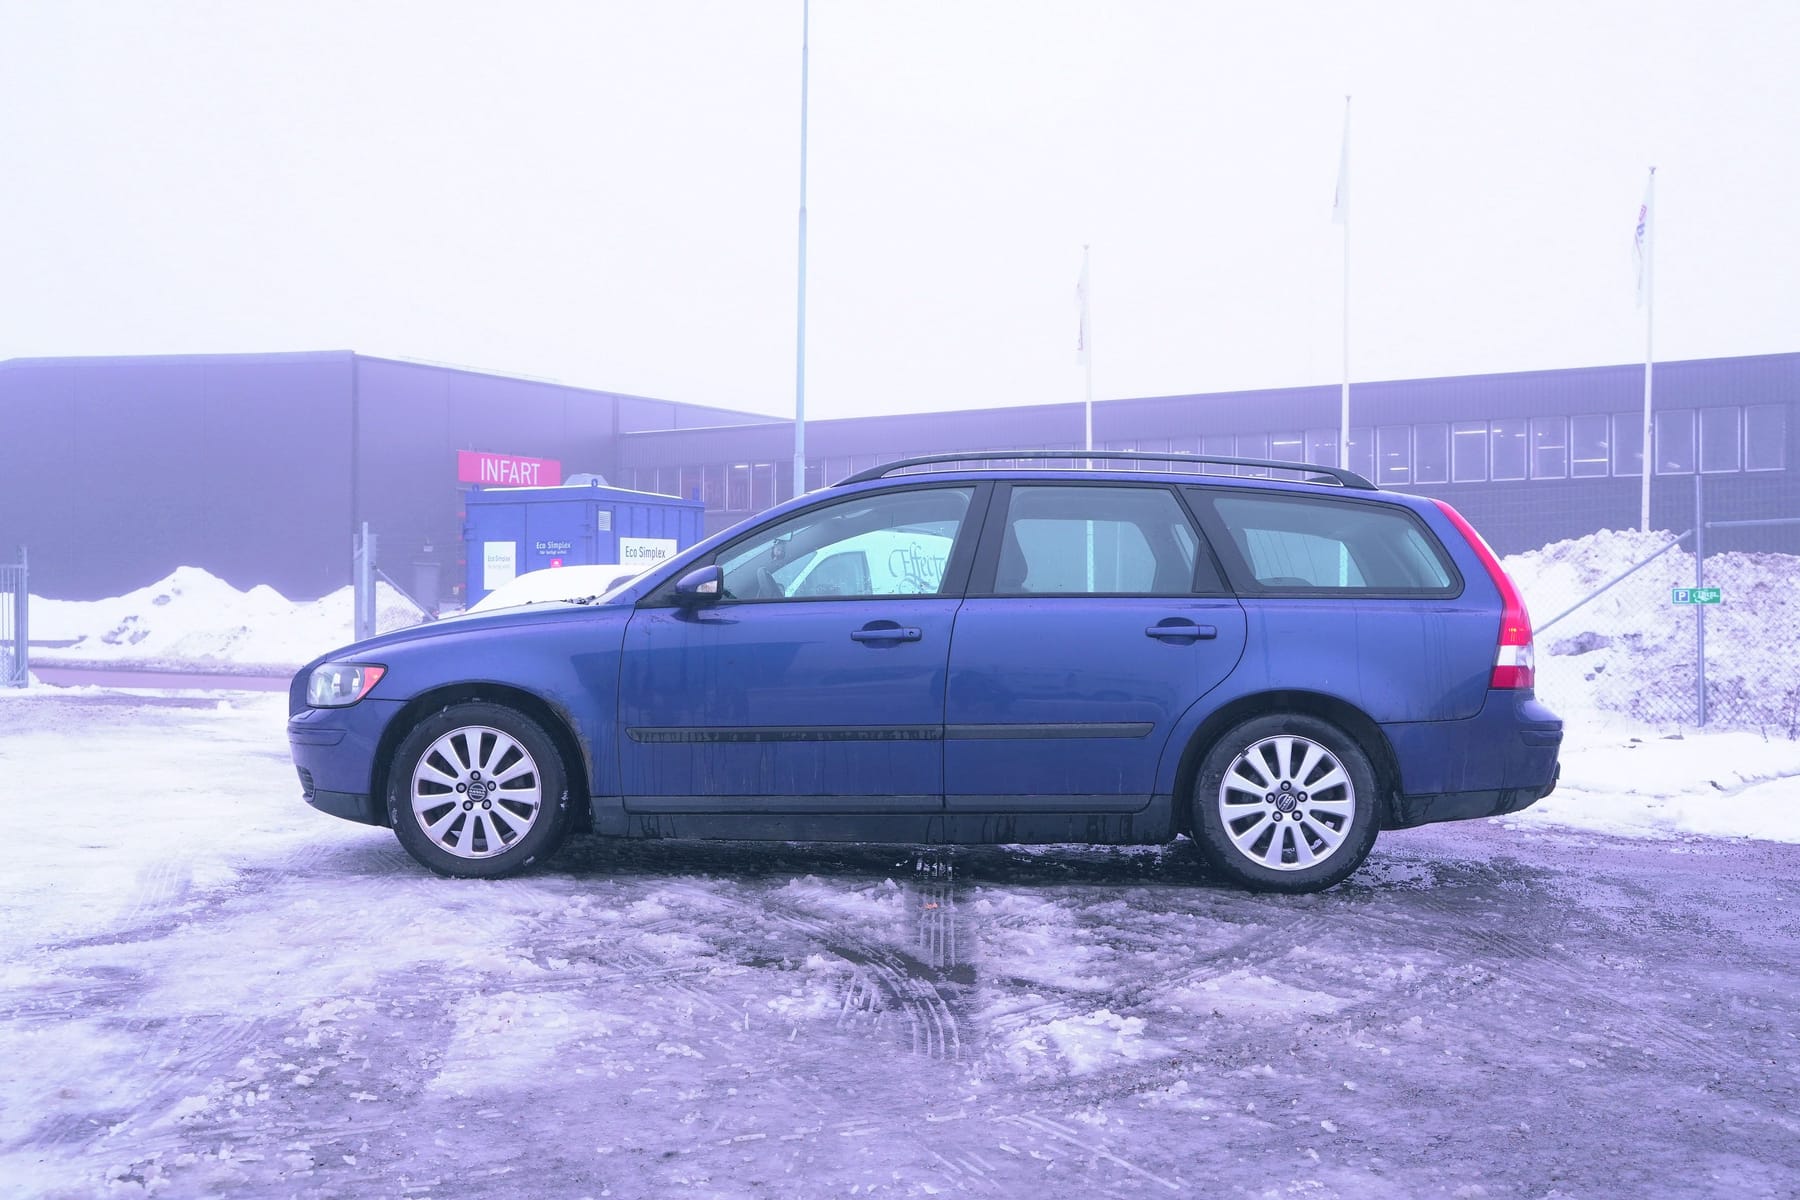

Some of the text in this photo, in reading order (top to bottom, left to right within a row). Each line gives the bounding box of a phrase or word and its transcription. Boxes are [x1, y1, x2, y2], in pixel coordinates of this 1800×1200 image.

[481, 458, 540, 485] INFART
[625, 545, 666, 561] Eco Simplex
[1678, 591, 1686, 601] P
